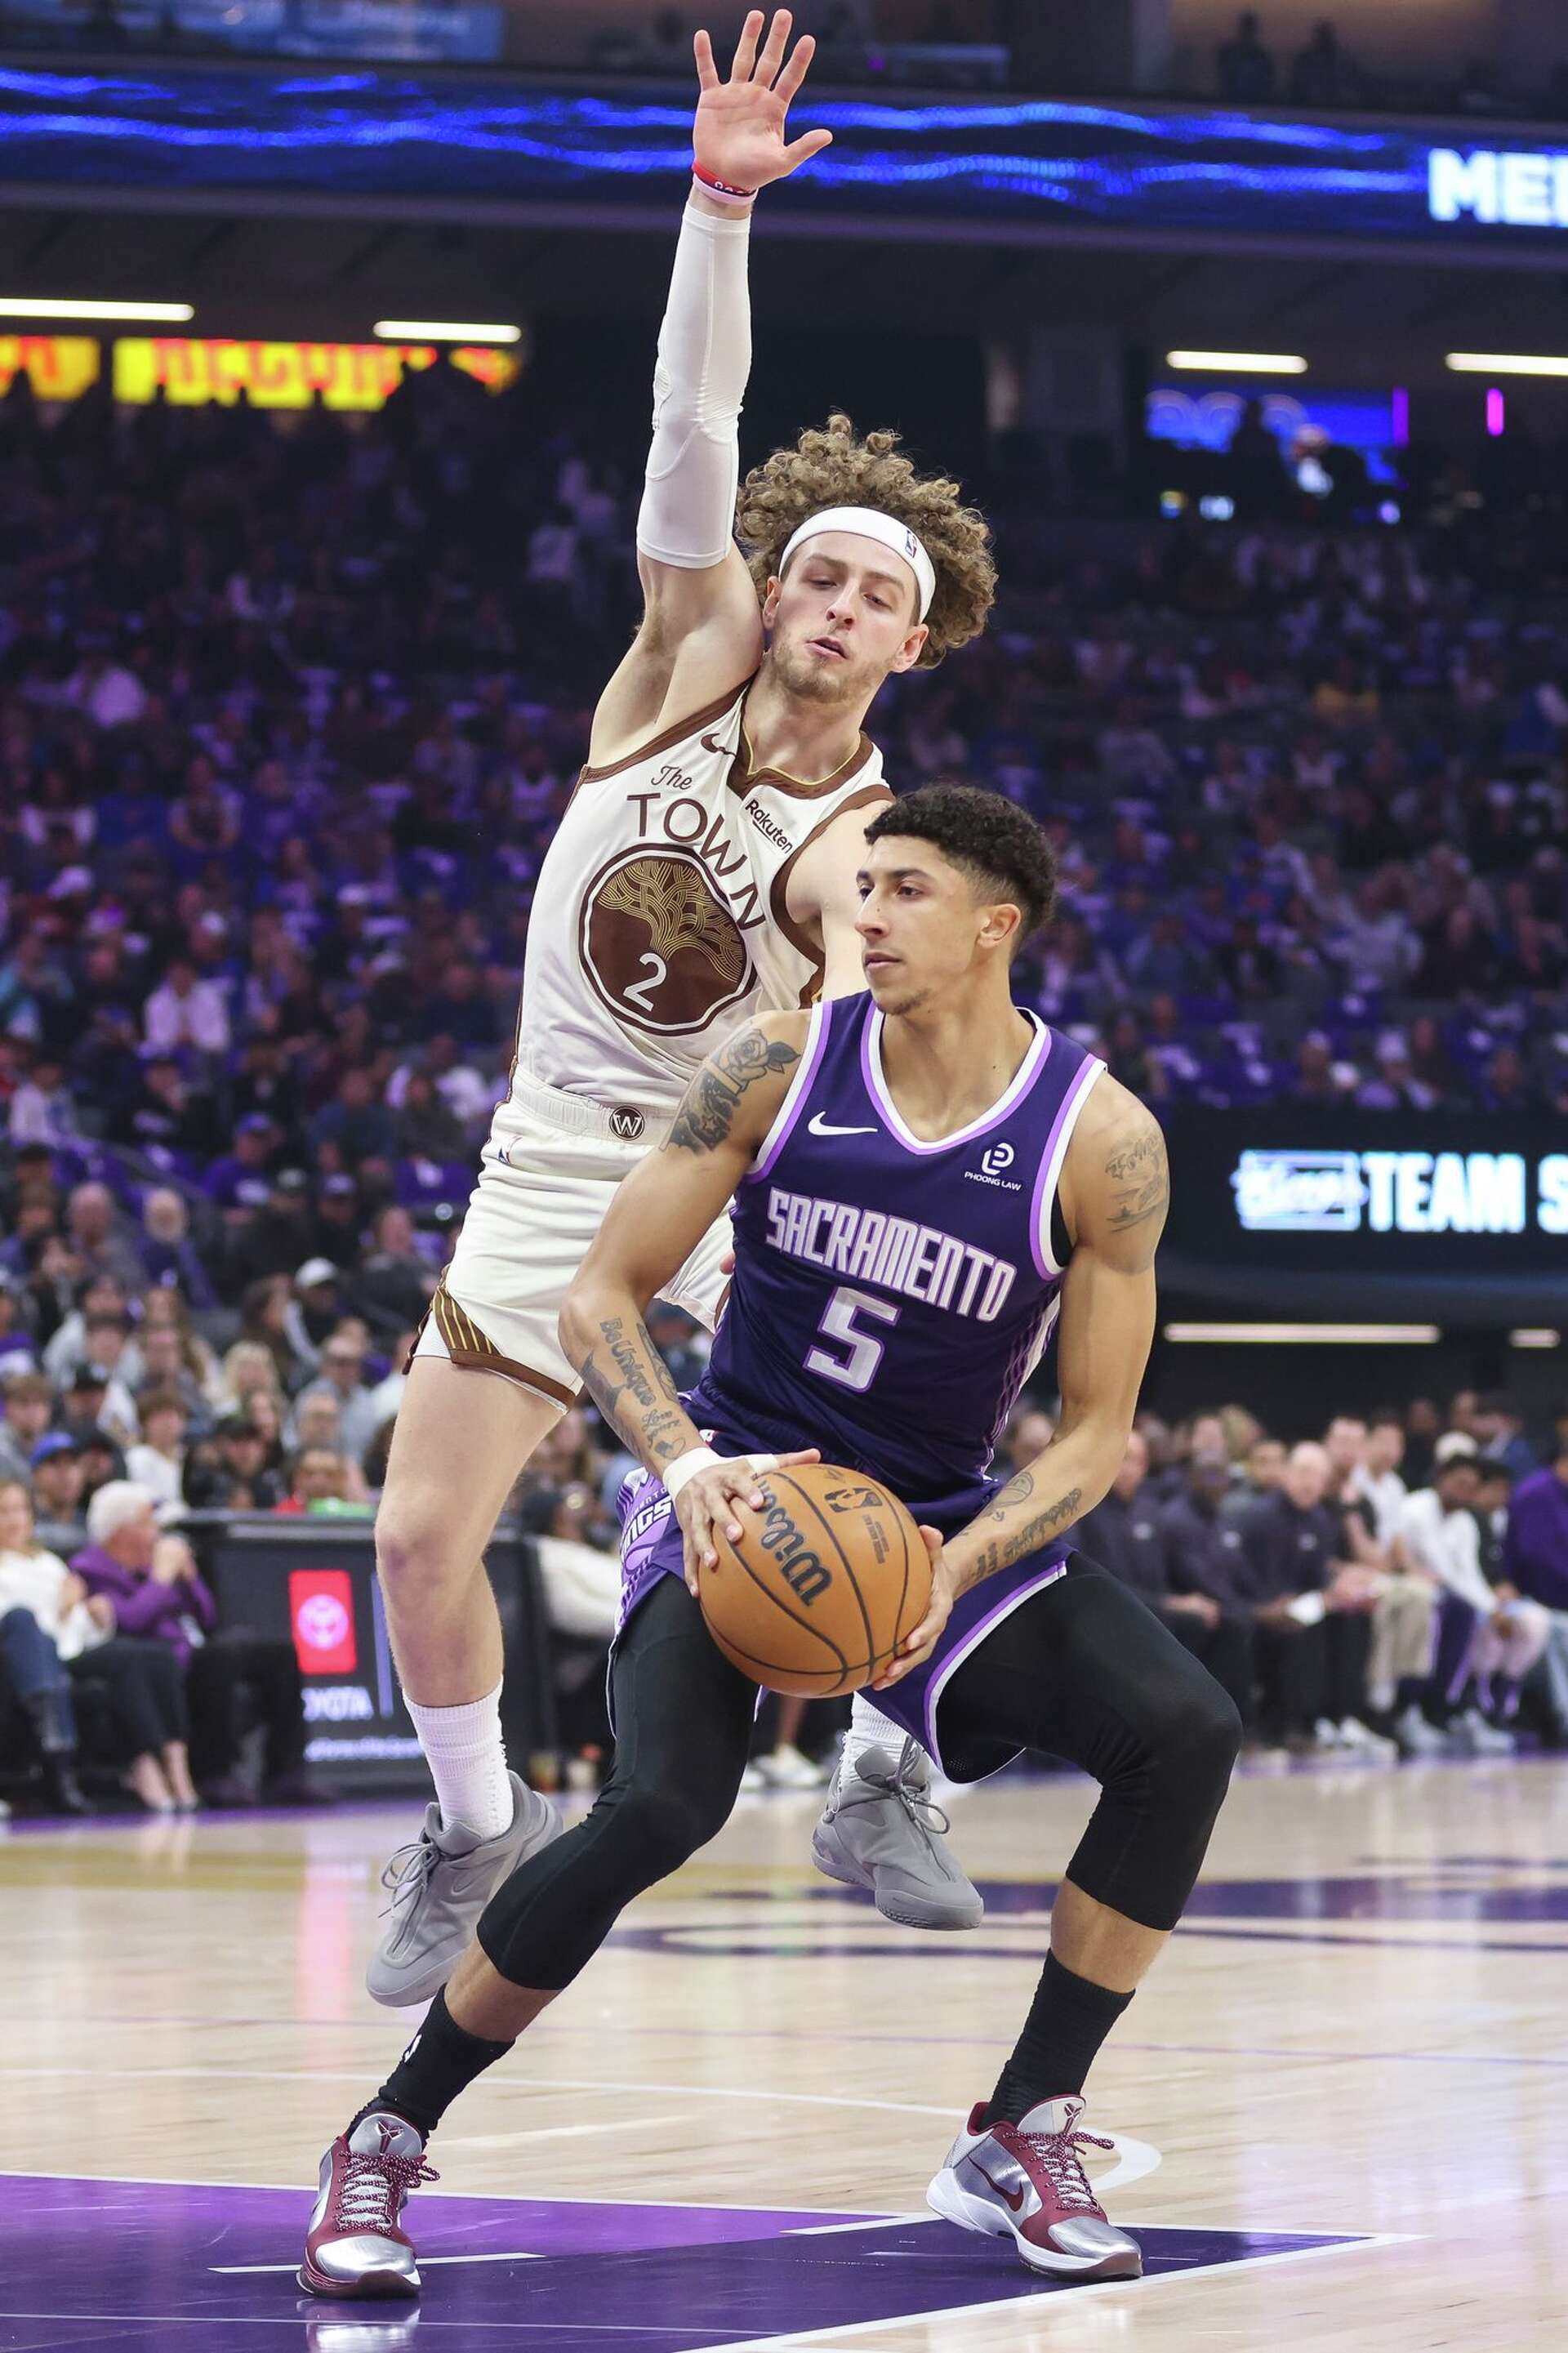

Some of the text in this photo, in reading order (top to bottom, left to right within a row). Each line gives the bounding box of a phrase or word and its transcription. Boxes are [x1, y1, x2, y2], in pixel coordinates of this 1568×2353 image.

[651, 765, 693, 790] The
[626, 792, 766, 931] TOWN
[745, 799, 793, 854] Rakuten
[622, 952, 667, 1012] 2
[964, 1171, 1022, 1192] PHOONG LAW
[1361, 1151, 1518, 1233] TEAM
[765, 1187, 1018, 1322] SACRAMENTO
[803, 1286, 901, 1393] 5
